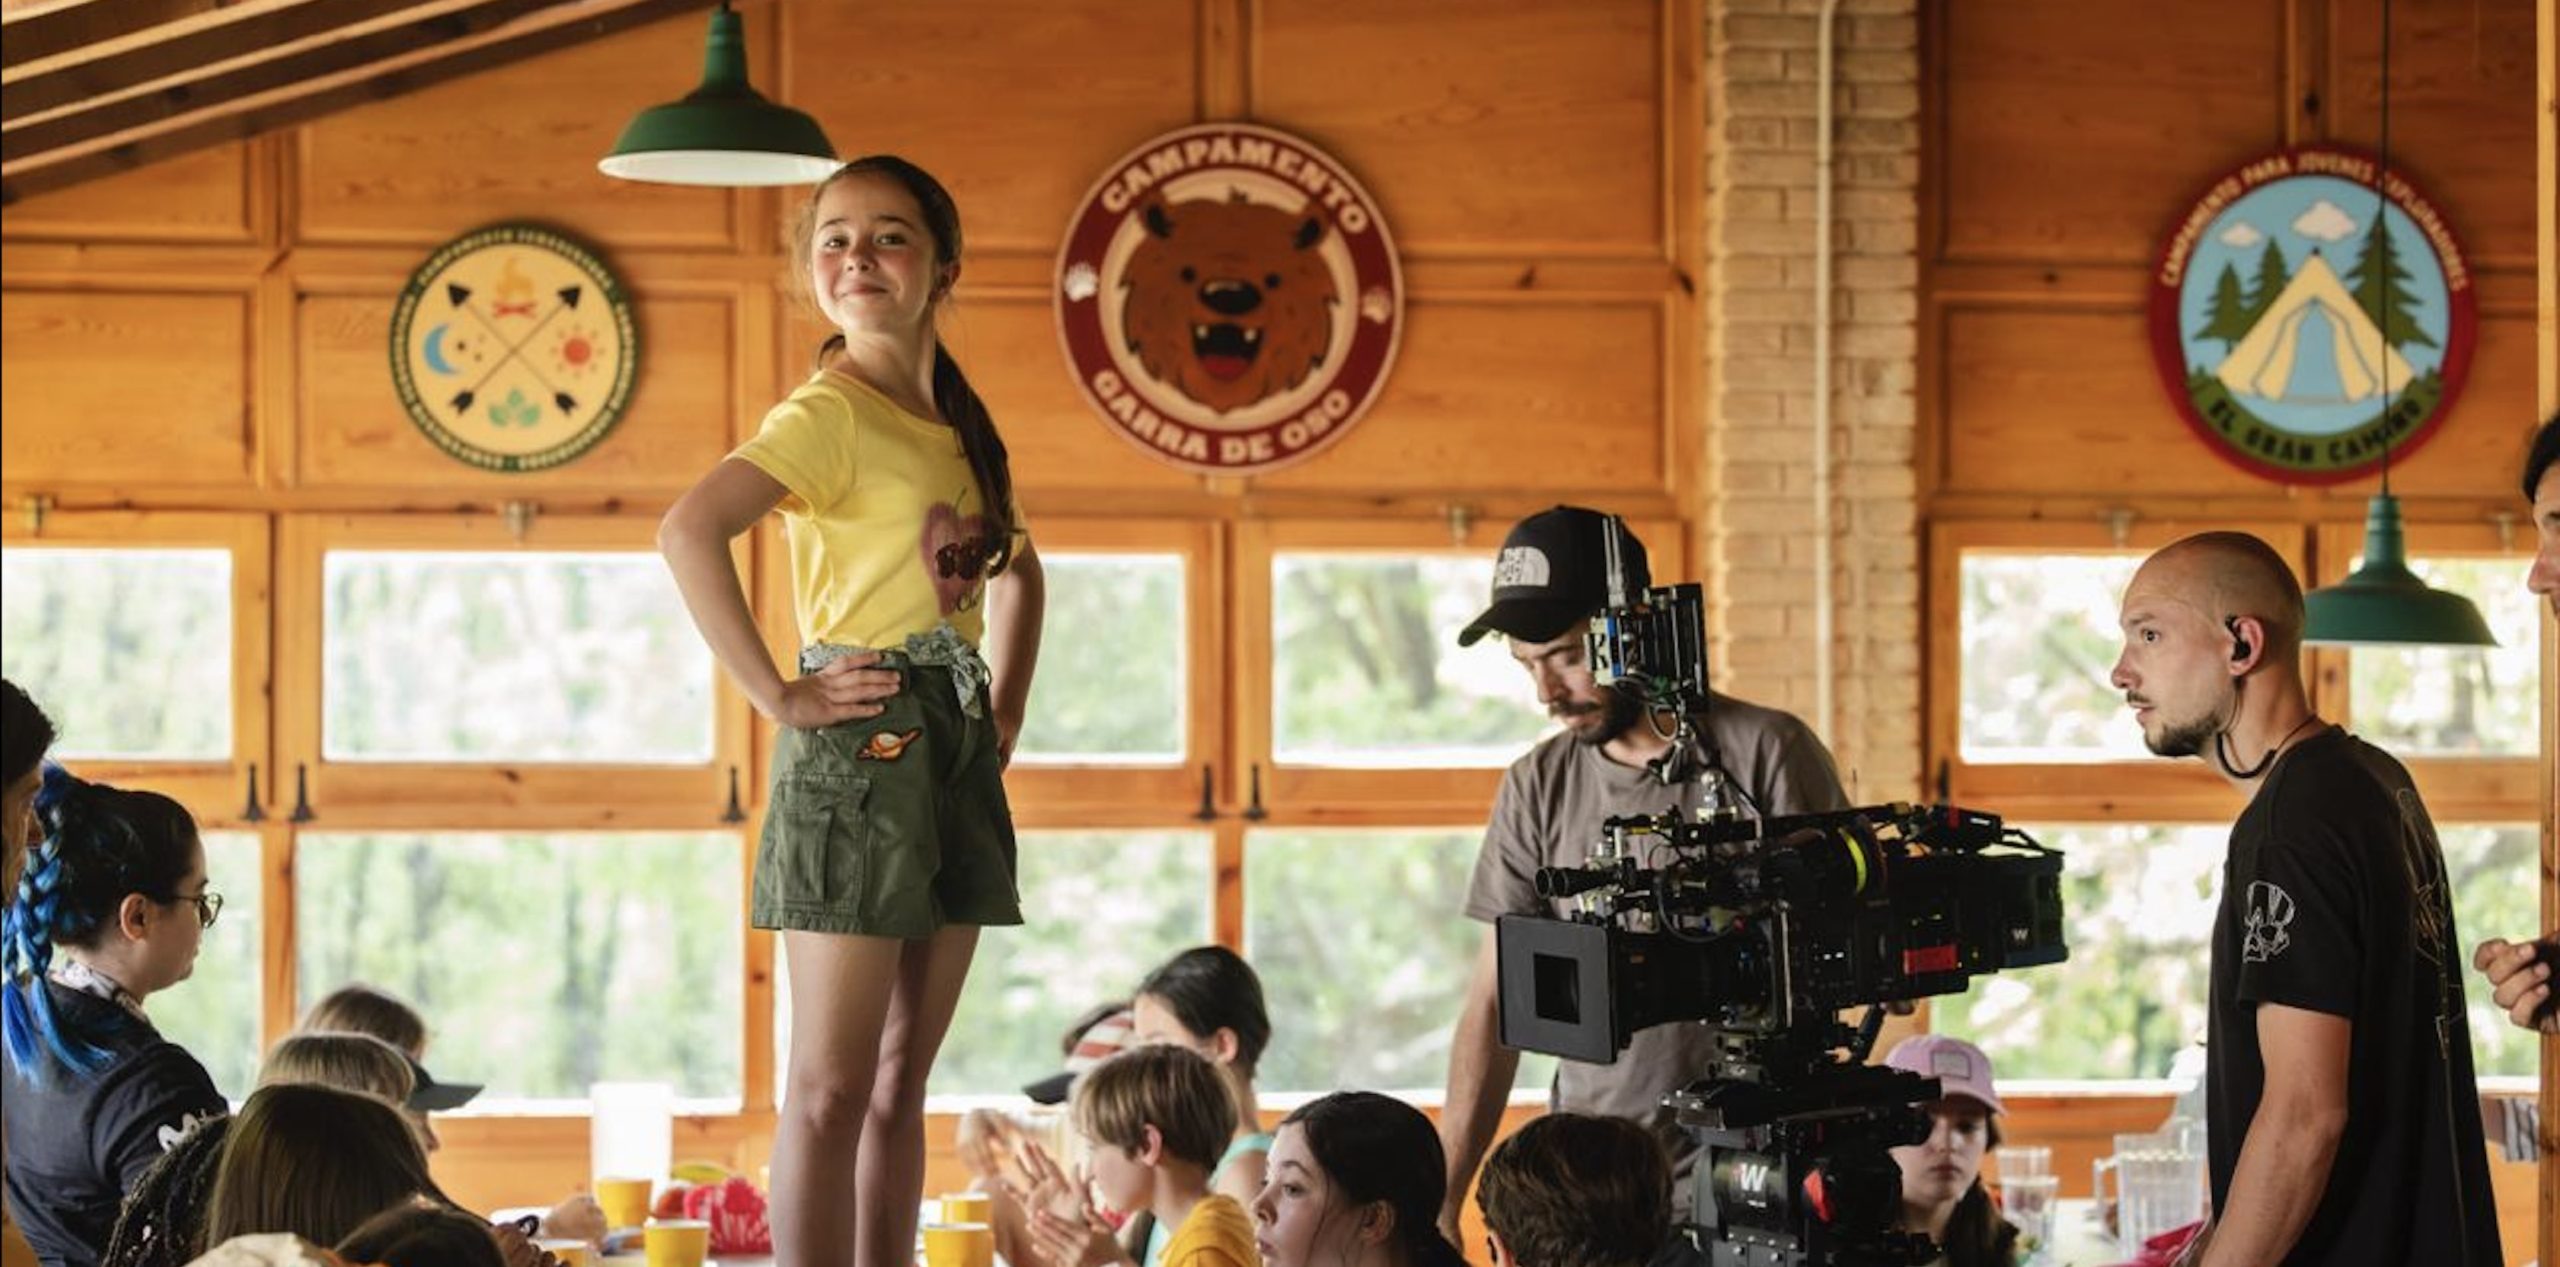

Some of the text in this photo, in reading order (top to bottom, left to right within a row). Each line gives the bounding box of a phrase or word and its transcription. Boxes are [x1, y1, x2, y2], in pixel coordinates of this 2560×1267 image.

[1102, 137, 1368, 233] CAMPAMENTO
[1094, 371, 1349, 463] GARRA DE OSO
[2208, 400, 2235, 432] EL
[2245, 427, 2314, 462] GRAN
[1740, 1162, 1768, 1192] W
